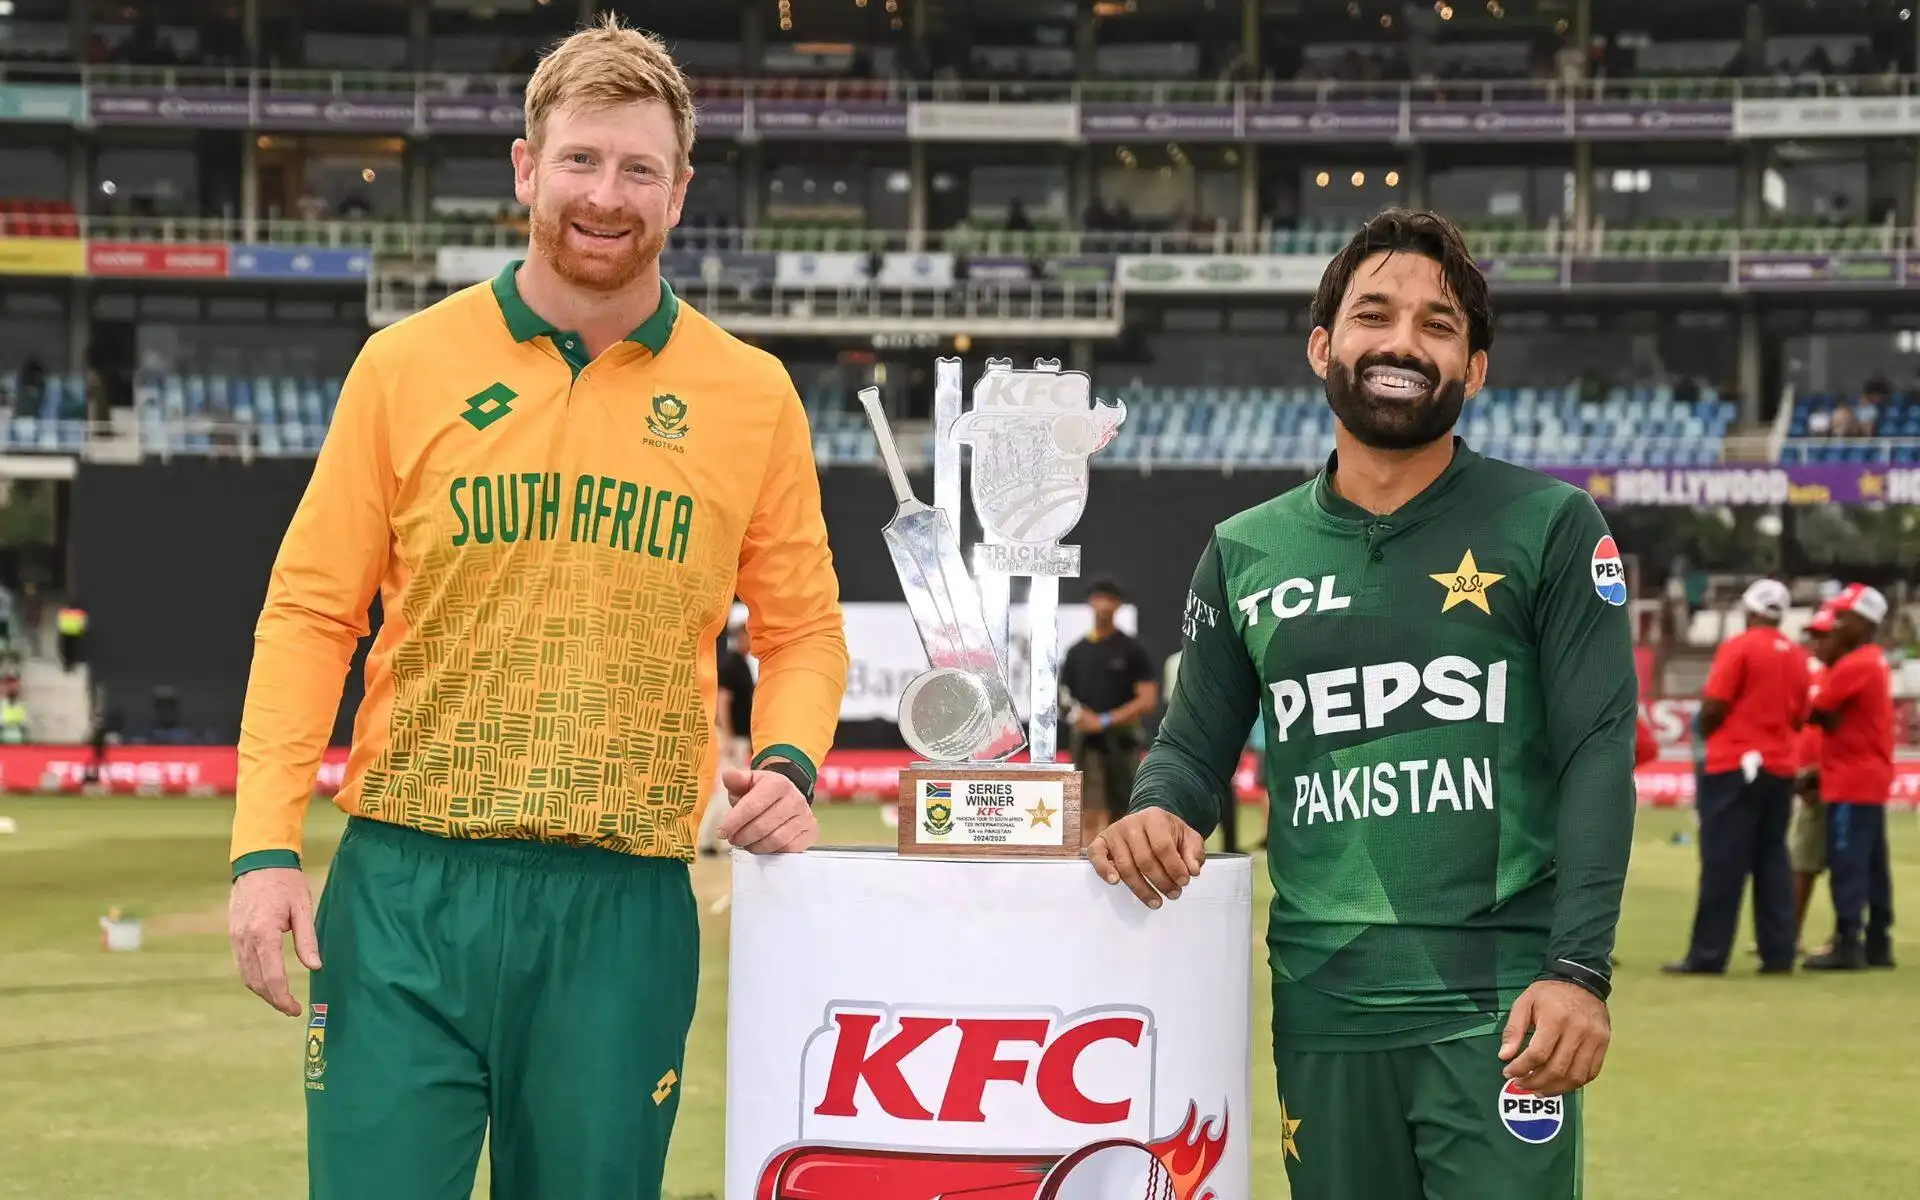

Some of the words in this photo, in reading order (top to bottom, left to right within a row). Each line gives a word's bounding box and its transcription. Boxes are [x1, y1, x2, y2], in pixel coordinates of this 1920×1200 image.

[984, 376, 1086, 407] KFC
[642, 437, 685, 454] PROTEAS
[1615, 468, 1788, 504] HOLLYWOOD
[450, 472, 561, 547] SOUTH
[571, 474, 693, 564] AFRICA
[981, 545, 1079, 561] CRICKE
[1237, 574, 1352, 627] TCL
[1269, 655, 1507, 742] PEPSI
[966, 796, 1014, 807] WINNER
[968, 784, 1012, 795] SERIES
[1293, 757, 1493, 827] PAKISTAN
[976, 807, 1004, 817] KFC
[814, 1013, 1144, 1125] KFC
[1504, 1099, 1560, 1115] PEPSI
